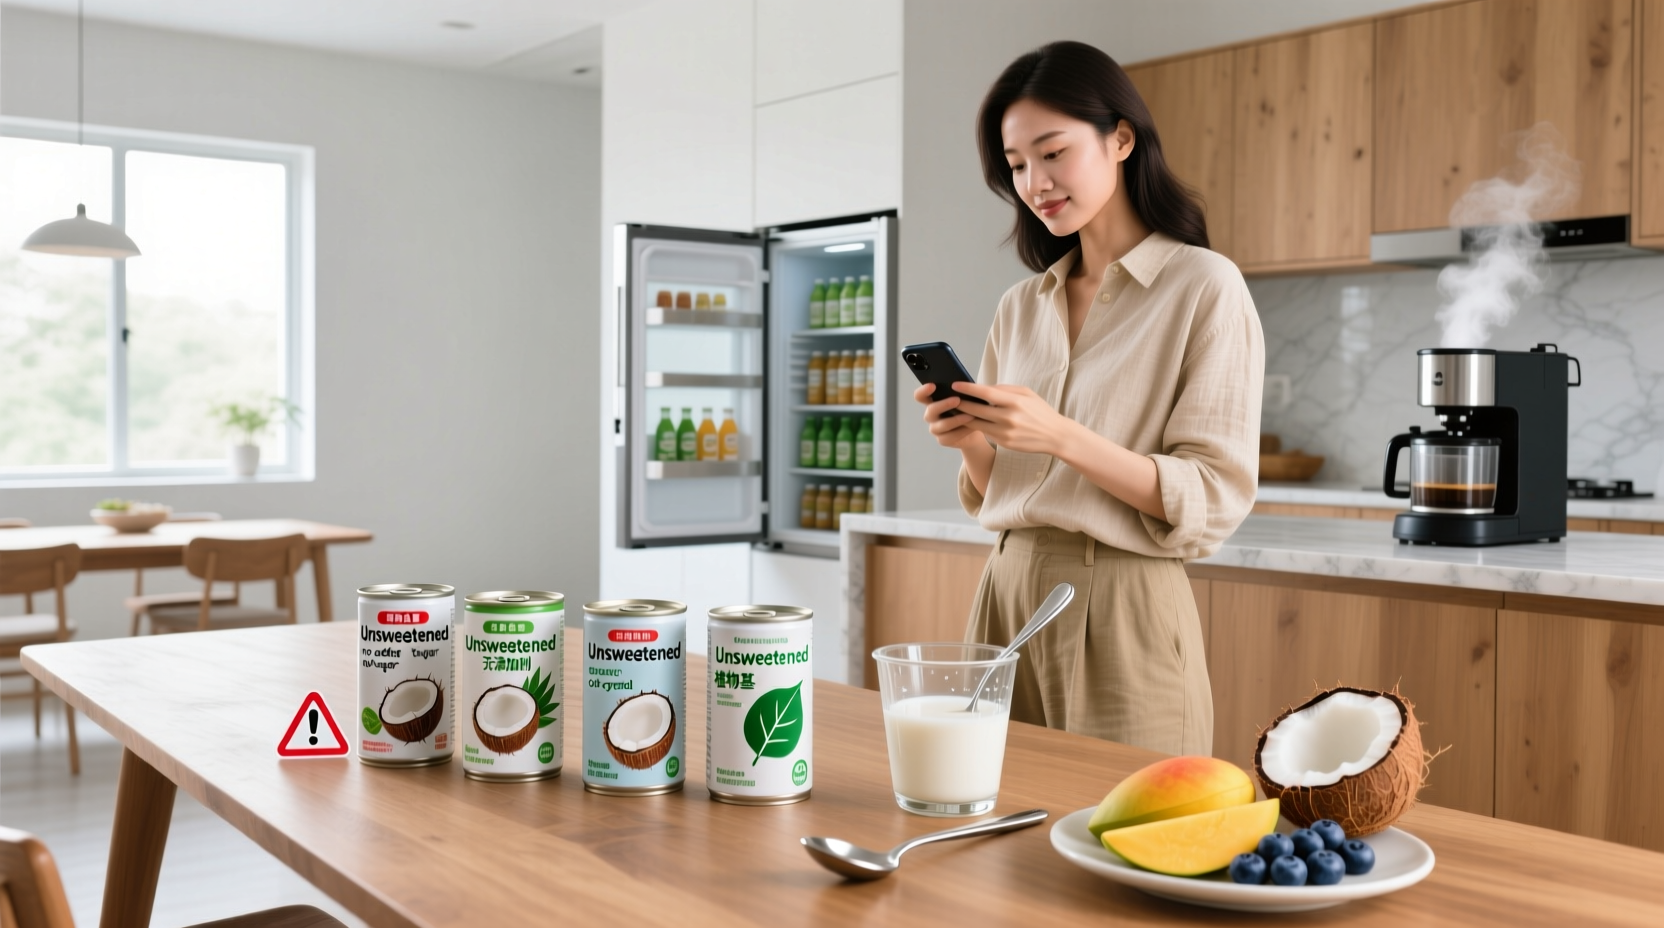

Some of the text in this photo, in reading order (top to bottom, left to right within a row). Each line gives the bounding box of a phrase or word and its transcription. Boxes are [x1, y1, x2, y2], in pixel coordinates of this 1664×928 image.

[361, 624, 449, 643] Unsweetened
[465, 633, 556, 653] Unsweetened
[588, 640, 681, 661] Unsweetened
[716, 644, 809, 666] Unsweetened
